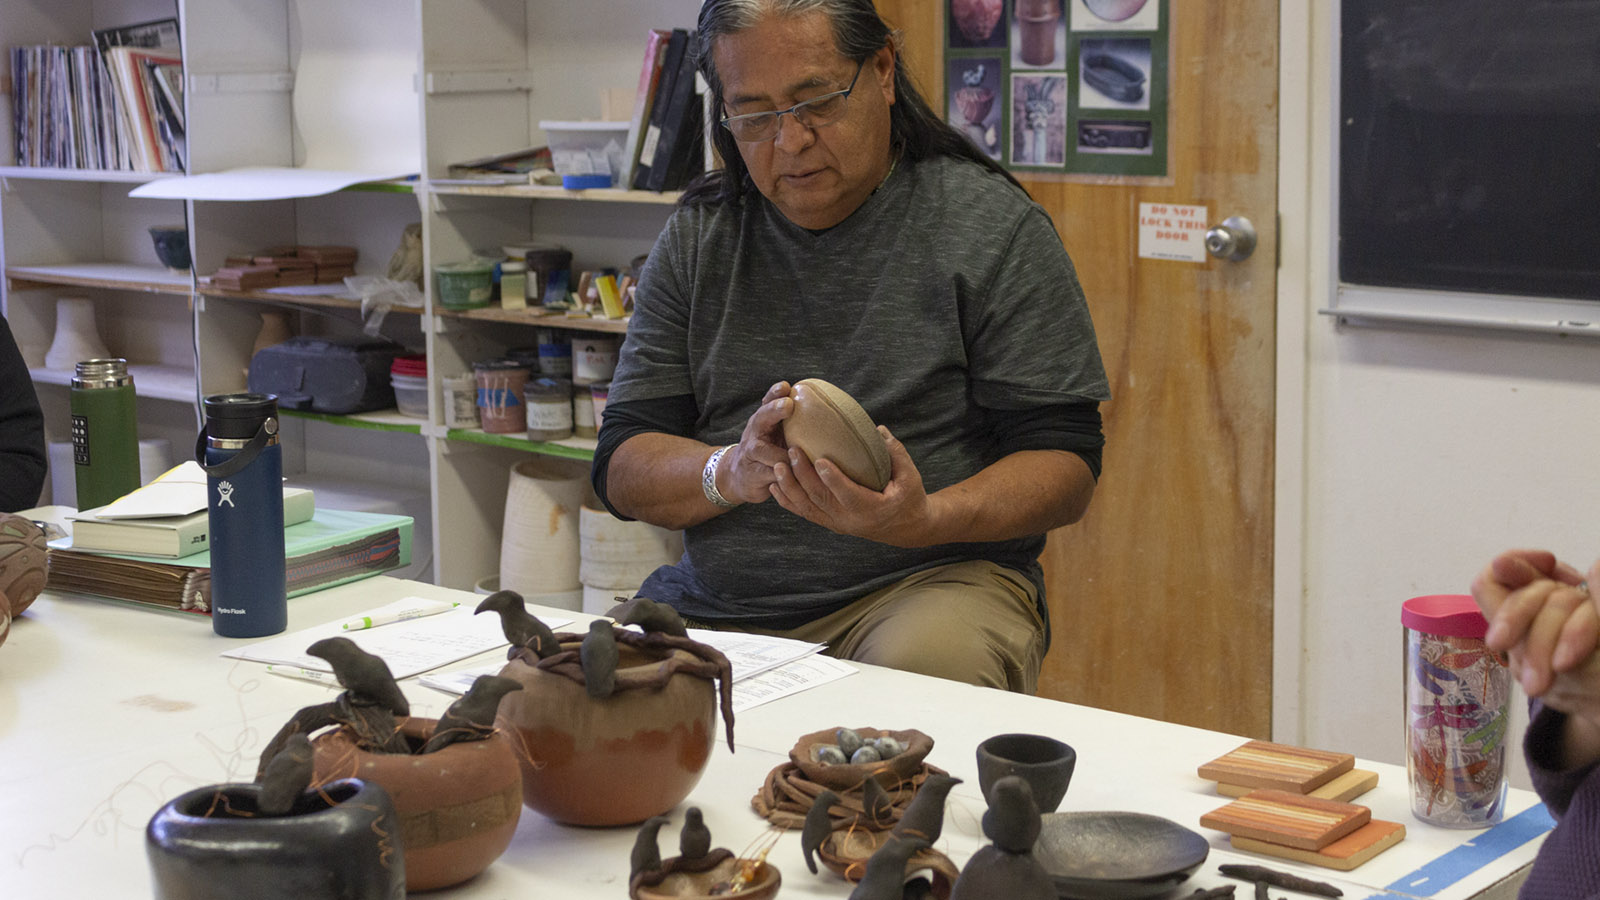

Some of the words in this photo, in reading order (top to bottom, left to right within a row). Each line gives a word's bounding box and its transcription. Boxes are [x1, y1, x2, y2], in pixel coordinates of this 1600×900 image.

[1151, 206, 1167, 215] DO
[1174, 207, 1195, 217] NOT
[1141, 216, 1172, 228] LOCK
[1178, 220, 1206, 230] THIS
[1156, 231, 1189, 241] DOOR
